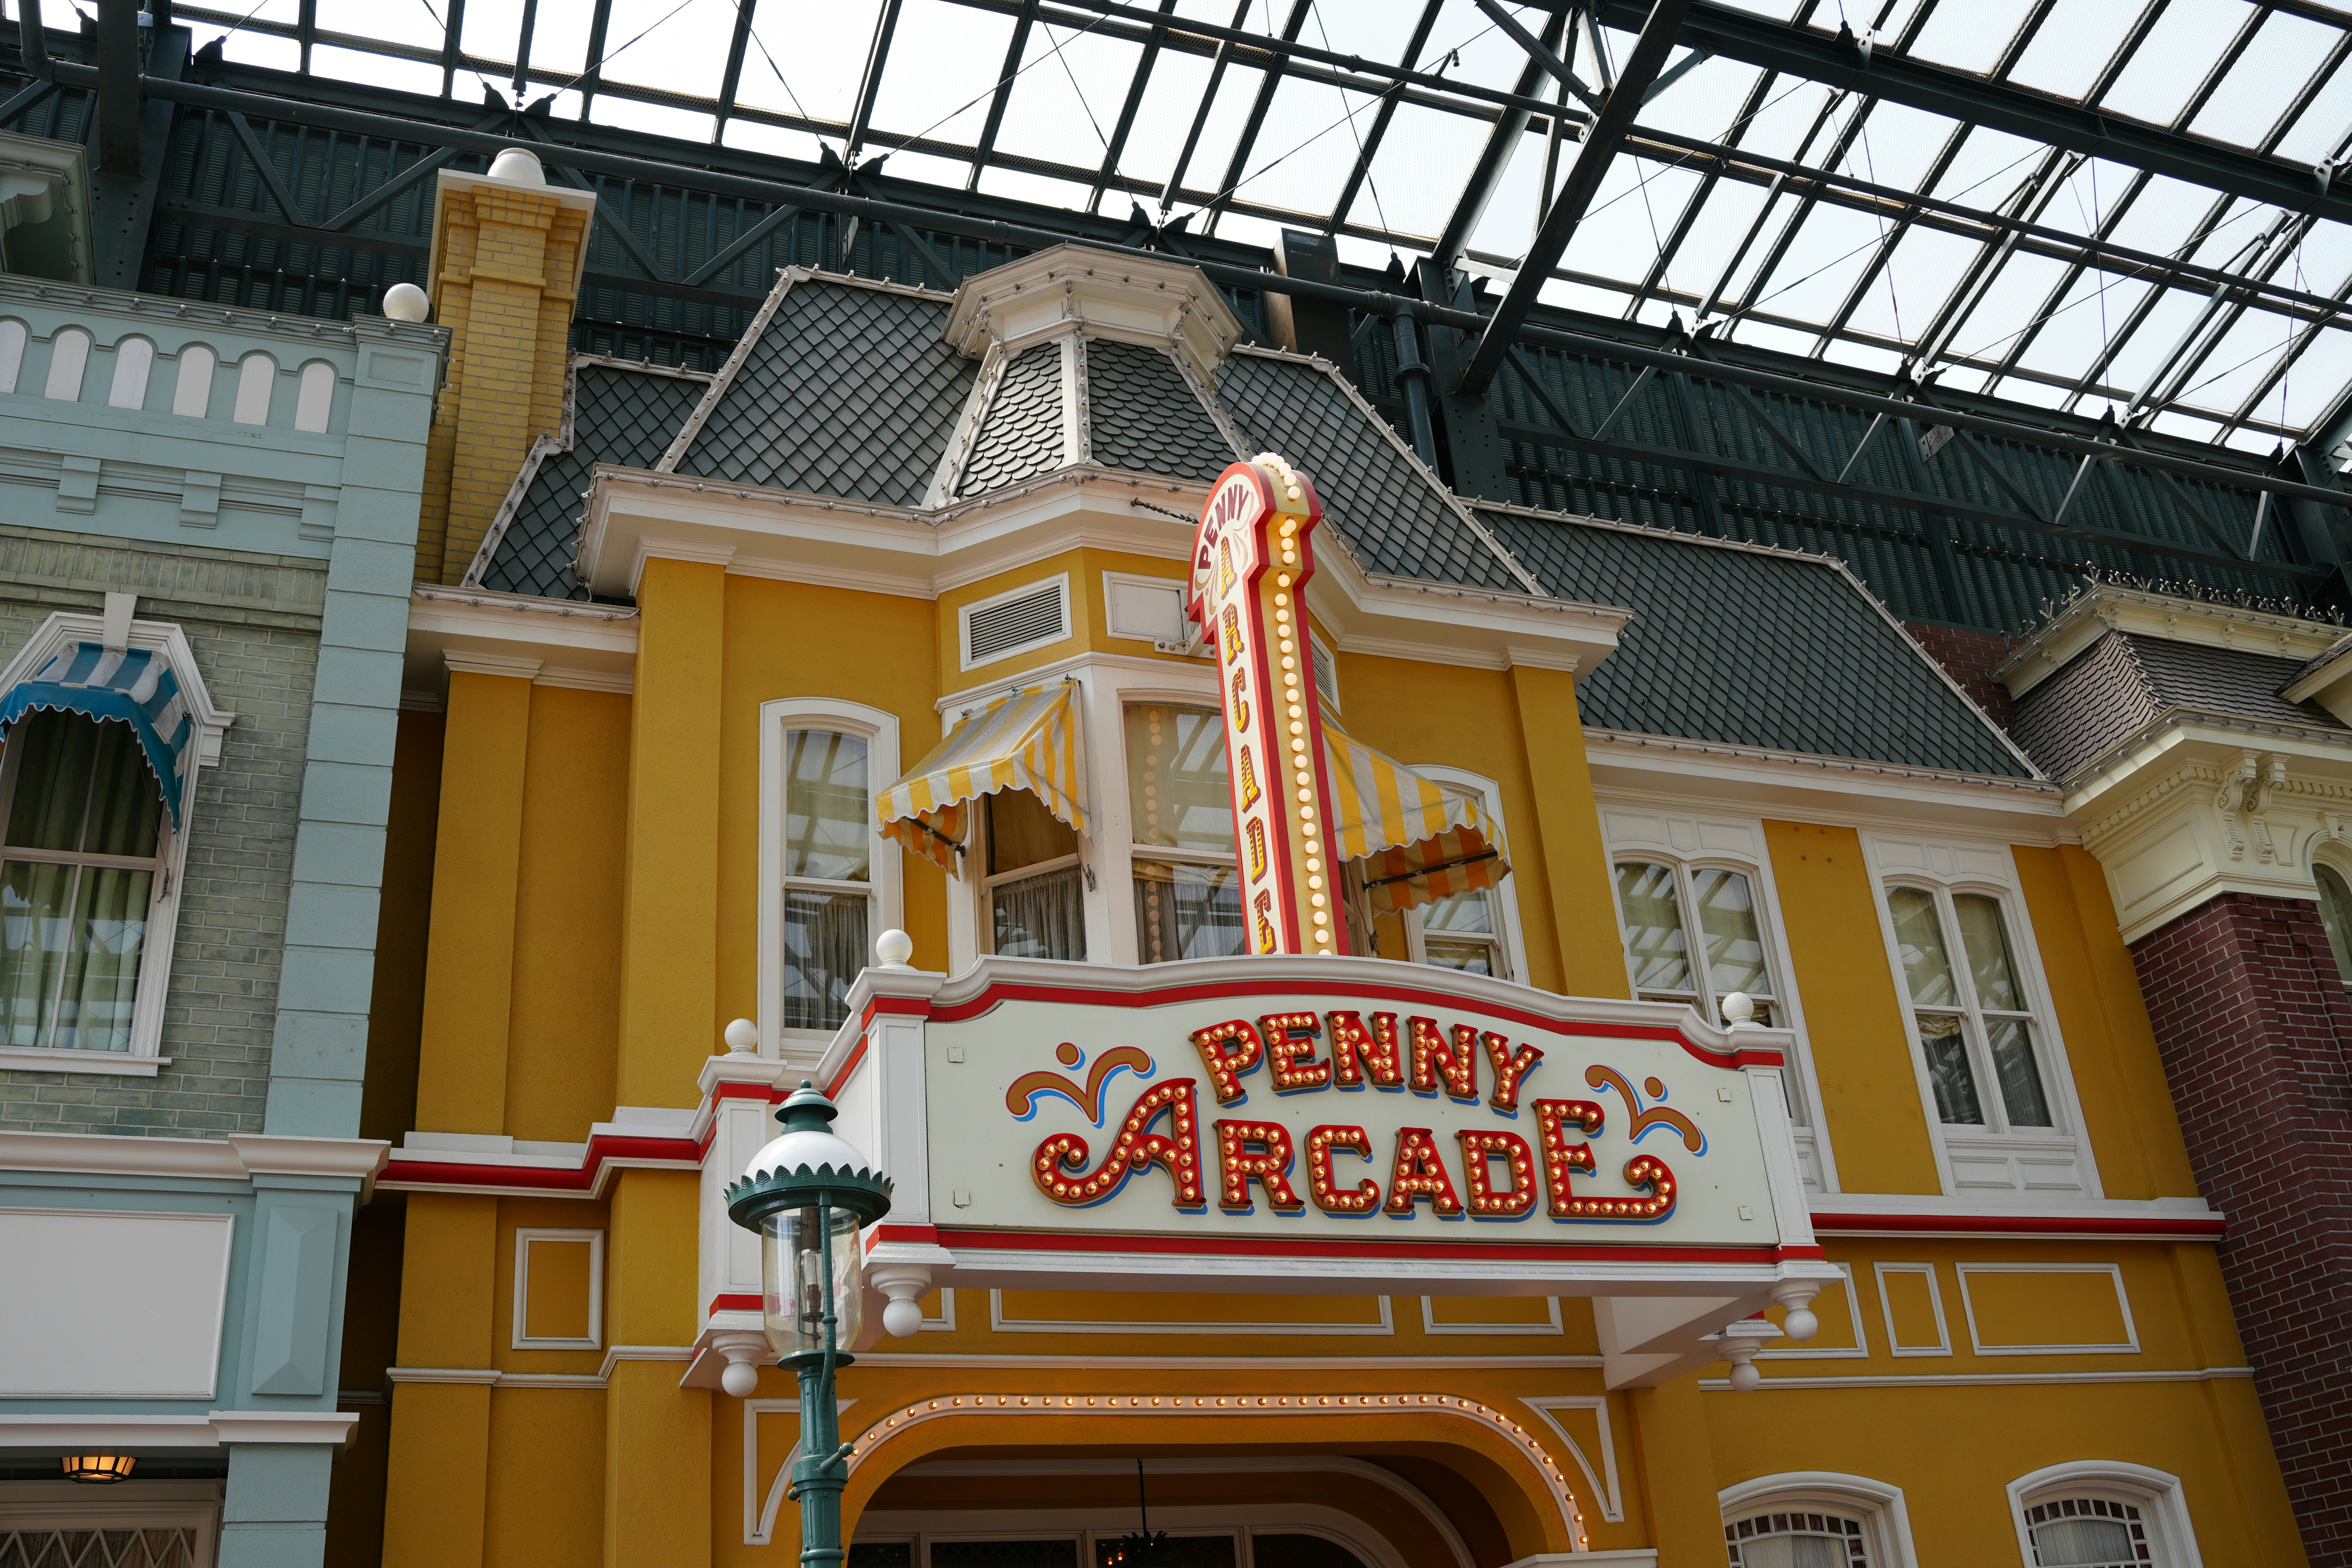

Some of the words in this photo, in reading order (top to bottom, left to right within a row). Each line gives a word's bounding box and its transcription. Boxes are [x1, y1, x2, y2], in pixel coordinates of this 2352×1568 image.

[1198, 484, 1249, 569] PENNY
[1220, 536, 1277, 955] ARCADE
[1188, 1010, 1543, 1113] PENNY
[1031, 1078, 1677, 1219] ARCADE
